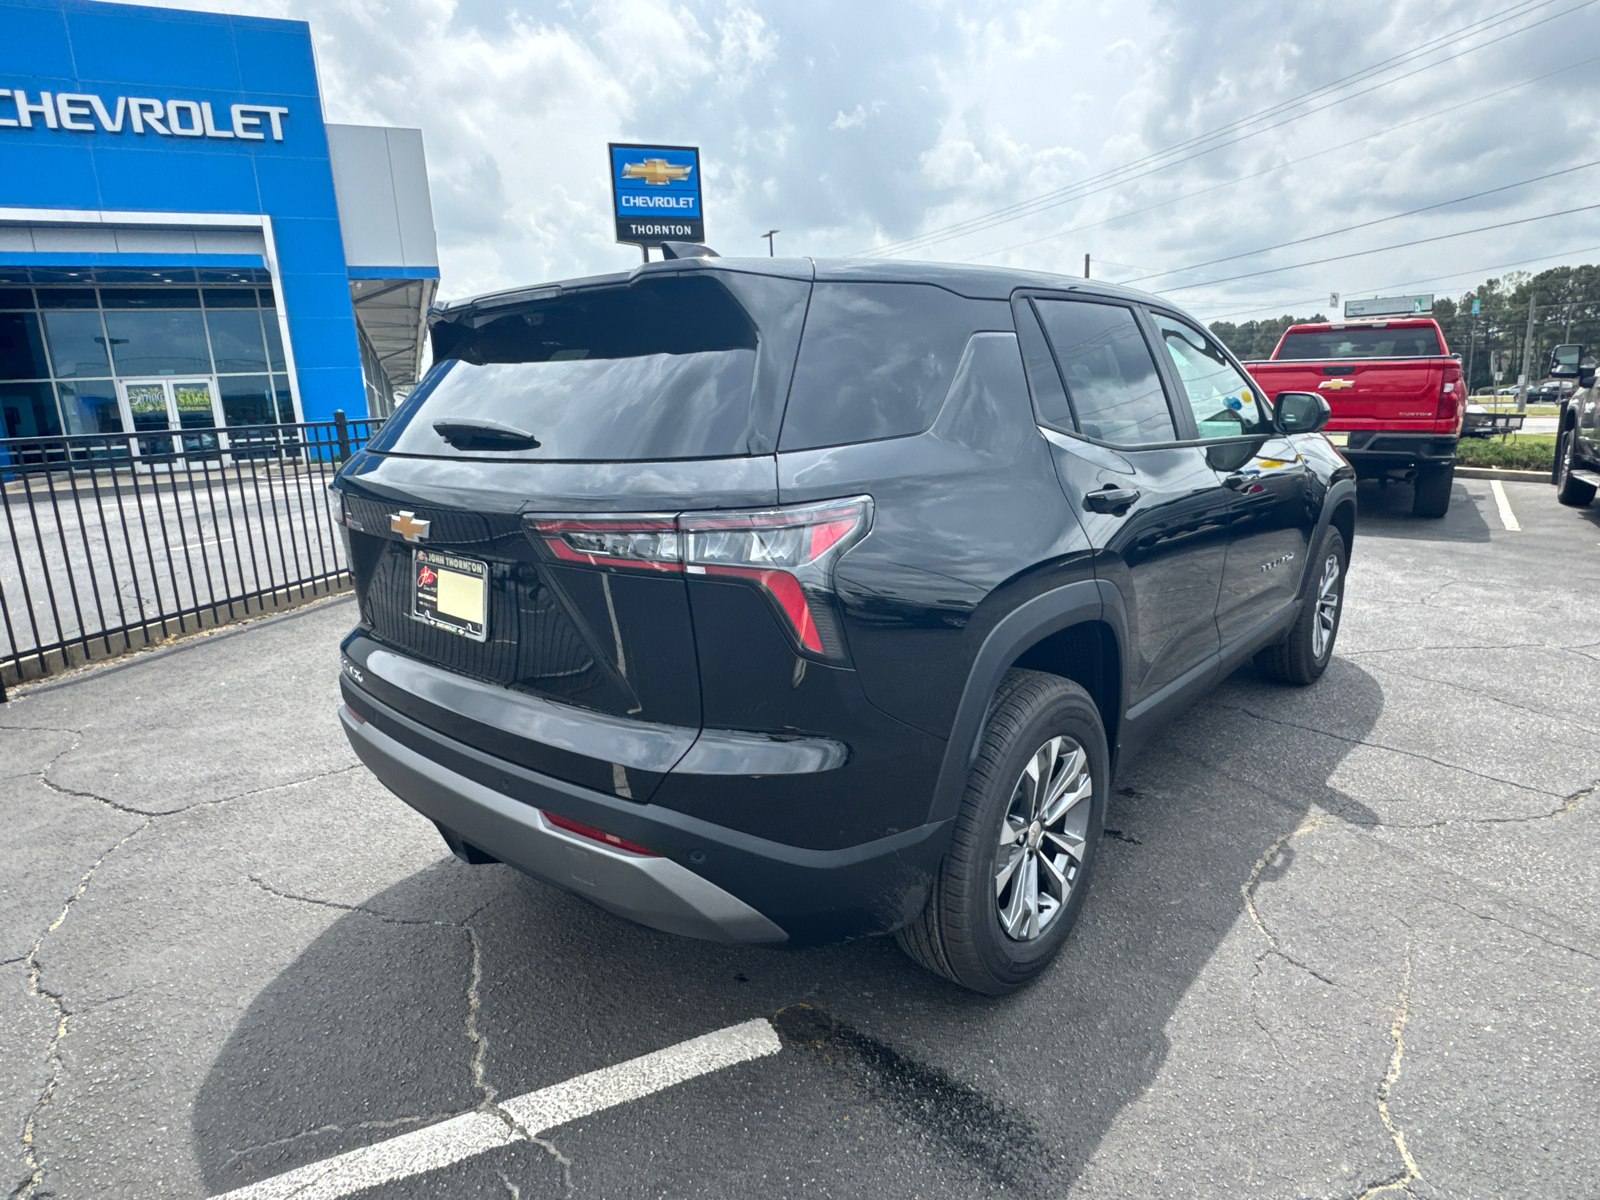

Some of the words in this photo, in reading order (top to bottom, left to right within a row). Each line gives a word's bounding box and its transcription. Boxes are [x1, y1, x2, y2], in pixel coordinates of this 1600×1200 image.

[621, 195, 695, 208] CHEVROLET
[630, 224, 692, 235] THORNTON
[428, 552, 445, 565] JOHN
[445, 556, 482, 574] THORNTON
